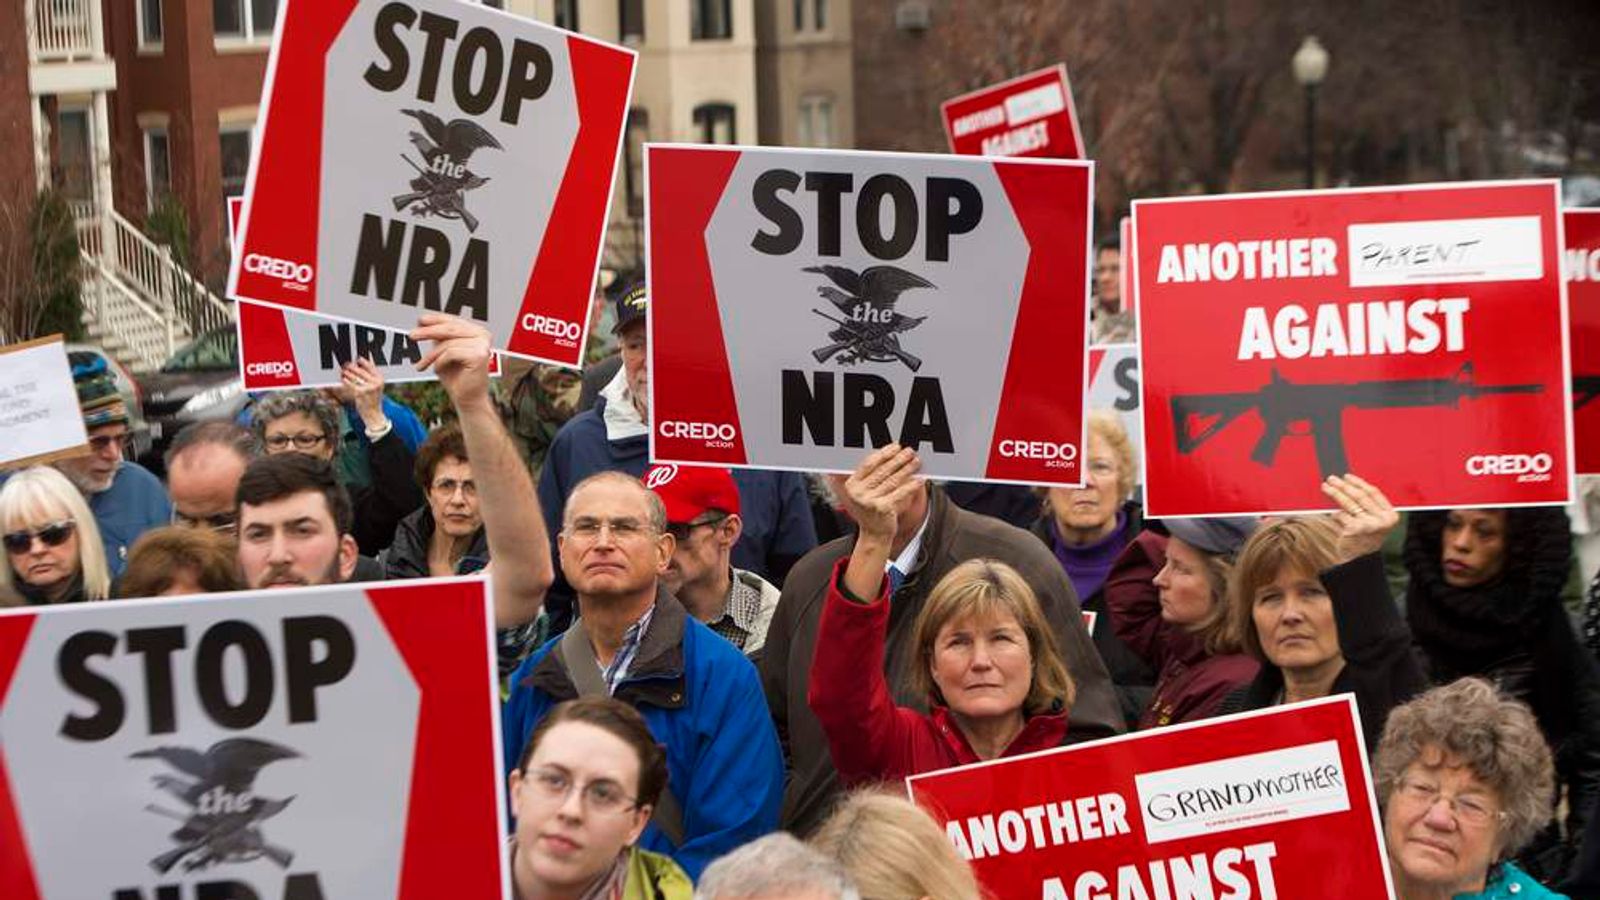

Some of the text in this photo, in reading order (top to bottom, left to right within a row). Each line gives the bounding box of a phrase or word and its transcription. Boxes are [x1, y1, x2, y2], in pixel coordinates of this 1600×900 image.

[363, 1, 554, 126] STOP
[430, 154, 465, 179] the
[750, 168, 984, 262] STOP
[244, 253, 313, 283] CREDO
[350, 213, 489, 322] NRA
[1156, 237, 1481, 284] ANOTHER PARENT
[522, 313, 581, 341] CREDO
[852, 302, 893, 324] the
[1237, 297, 1470, 361] AGAINST
[318, 323, 422, 370] NRA
[247, 361, 293, 376] CREDO
[781, 369, 954, 454] NRA
[659, 420, 736, 441] CREDO
[705, 440, 734, 449] action
[999, 439, 1077, 461] CREDO
[1044, 458, 1075, 469] action
[1466, 453, 1552, 475] CREDO
[56, 614, 357, 742] STOP
[198, 784, 252, 815] the
[945, 762, 1344, 862] ANOTHER GRANDMOTHER
